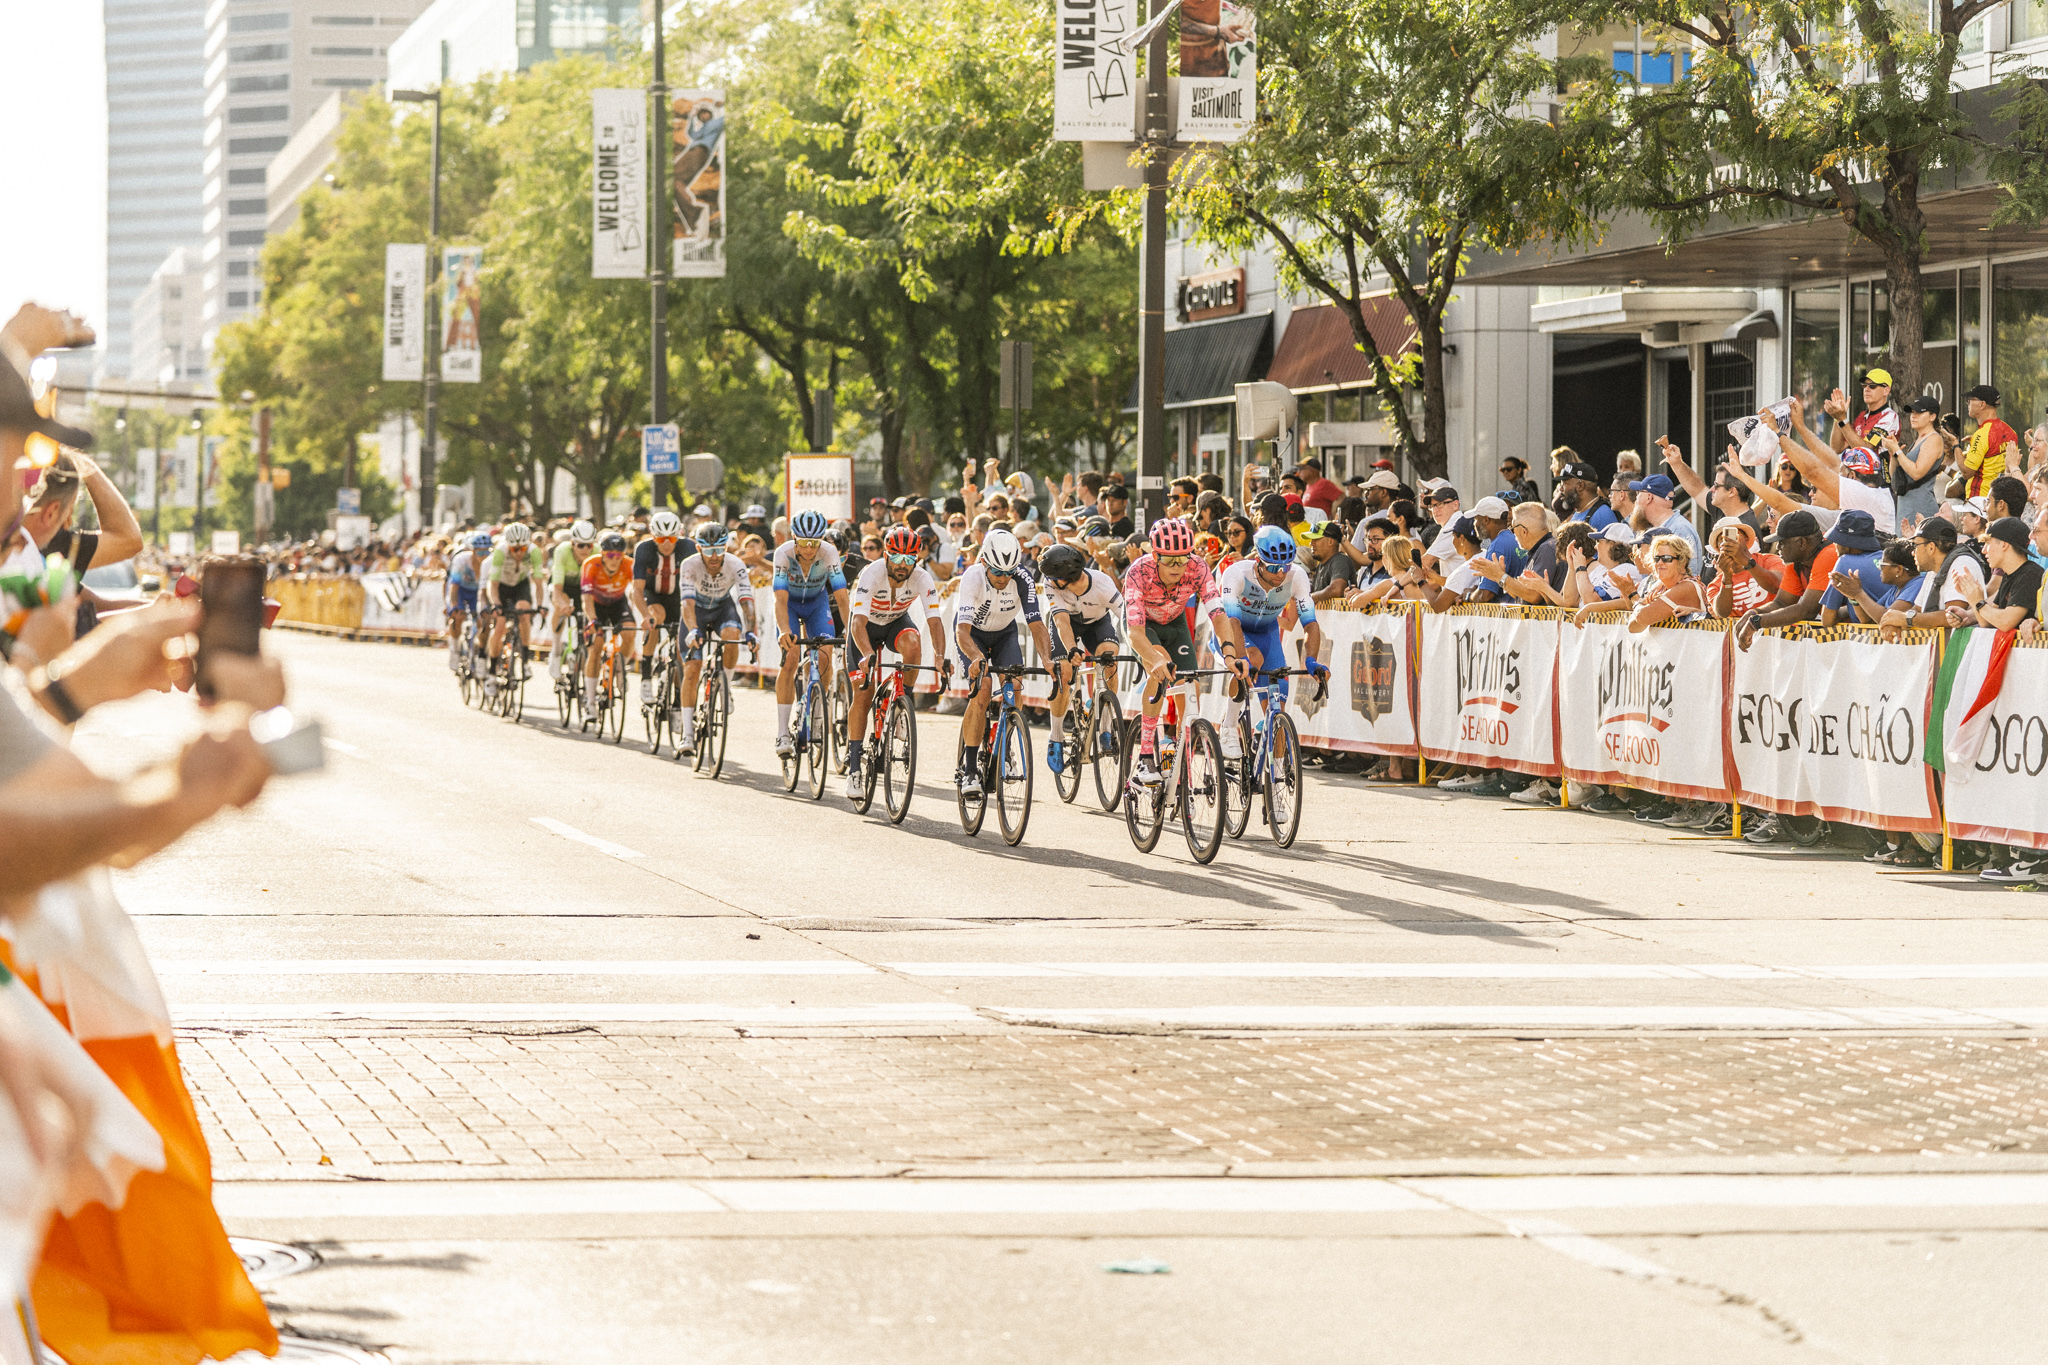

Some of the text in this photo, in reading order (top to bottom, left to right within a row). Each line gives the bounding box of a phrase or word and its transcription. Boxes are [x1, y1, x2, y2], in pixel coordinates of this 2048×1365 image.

[1191, 88, 1243, 119] BALTIMORE
[1192, 87, 1214, 102] VISIT
[599, 144, 619, 232] WELCOME
[1597, 639, 1676, 733] Phillips
[1461, 714, 1509, 746] SEAOOD
[1604, 732, 1660, 767] SEAFOOD
[1808, 714, 1839, 756] DE
[1847, 693, 1914, 766] CHÃO
[1975, 713, 2048, 777] OGO
